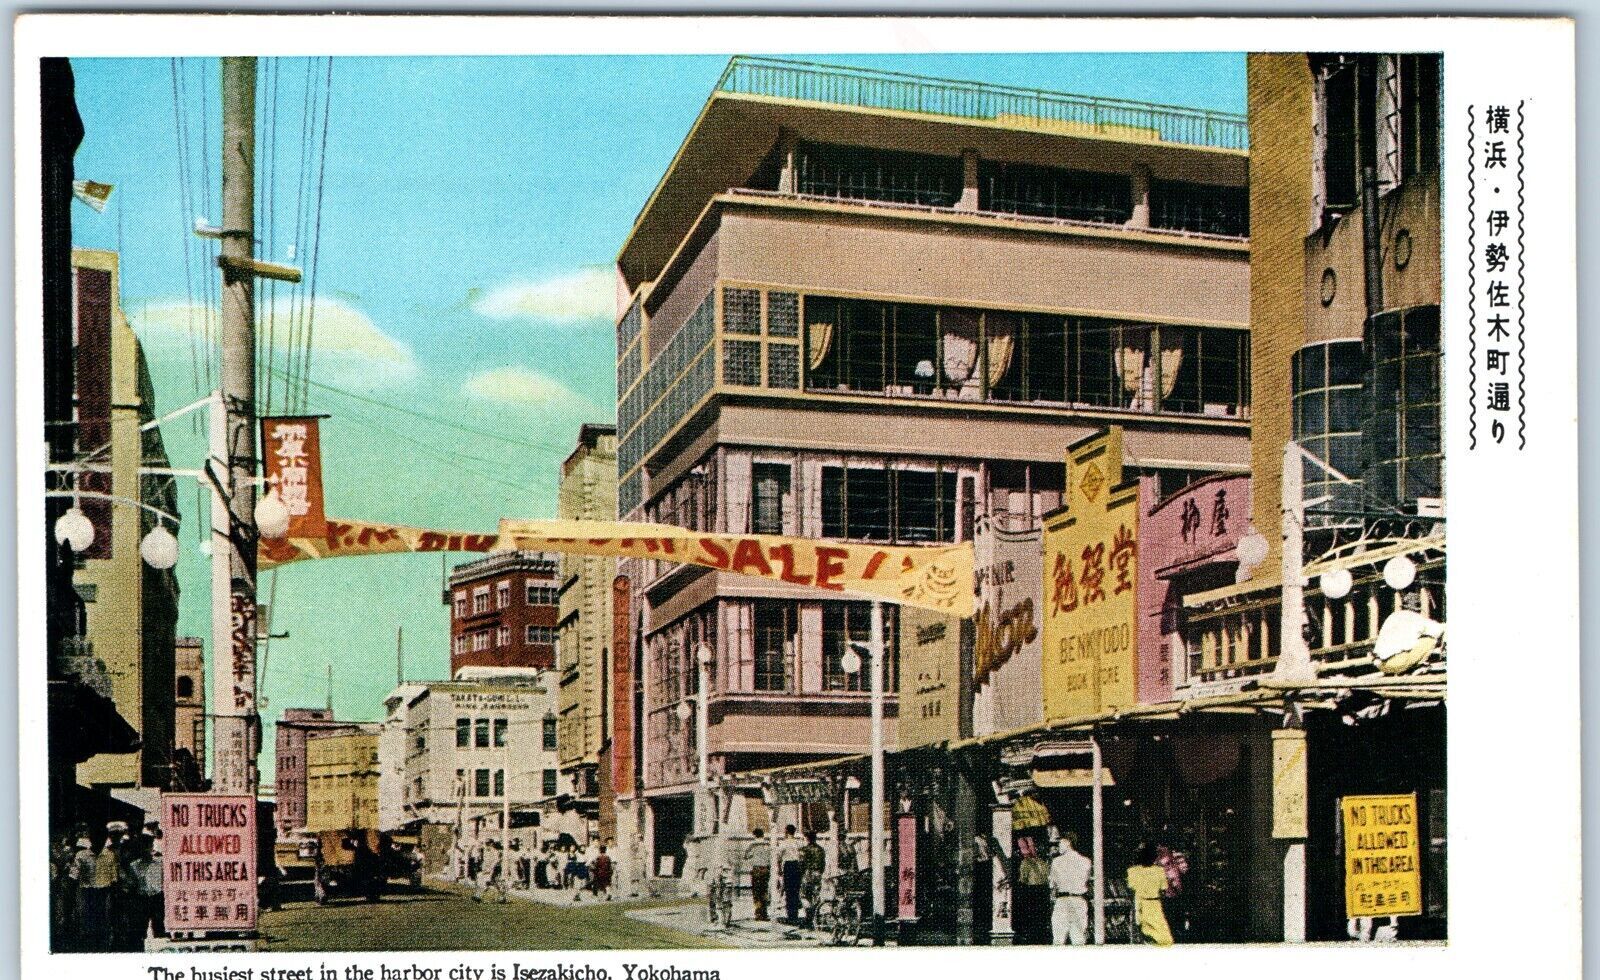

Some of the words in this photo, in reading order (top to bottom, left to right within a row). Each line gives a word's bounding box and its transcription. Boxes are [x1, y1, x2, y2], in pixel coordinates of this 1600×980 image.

[170, 804, 189, 828] NO
[197, 804, 247, 828] TRUCKS
[1351, 805, 1367, 827] NO
[1371, 804, 1411, 826] TRUCKS
[180, 834, 241, 855] ALLOWED
[1357, 830, 1408, 850] ALLOWED
[170, 862, 183, 882] IN
[185, 862, 213, 882] THIS
[215, 862, 249, 882] AREA
